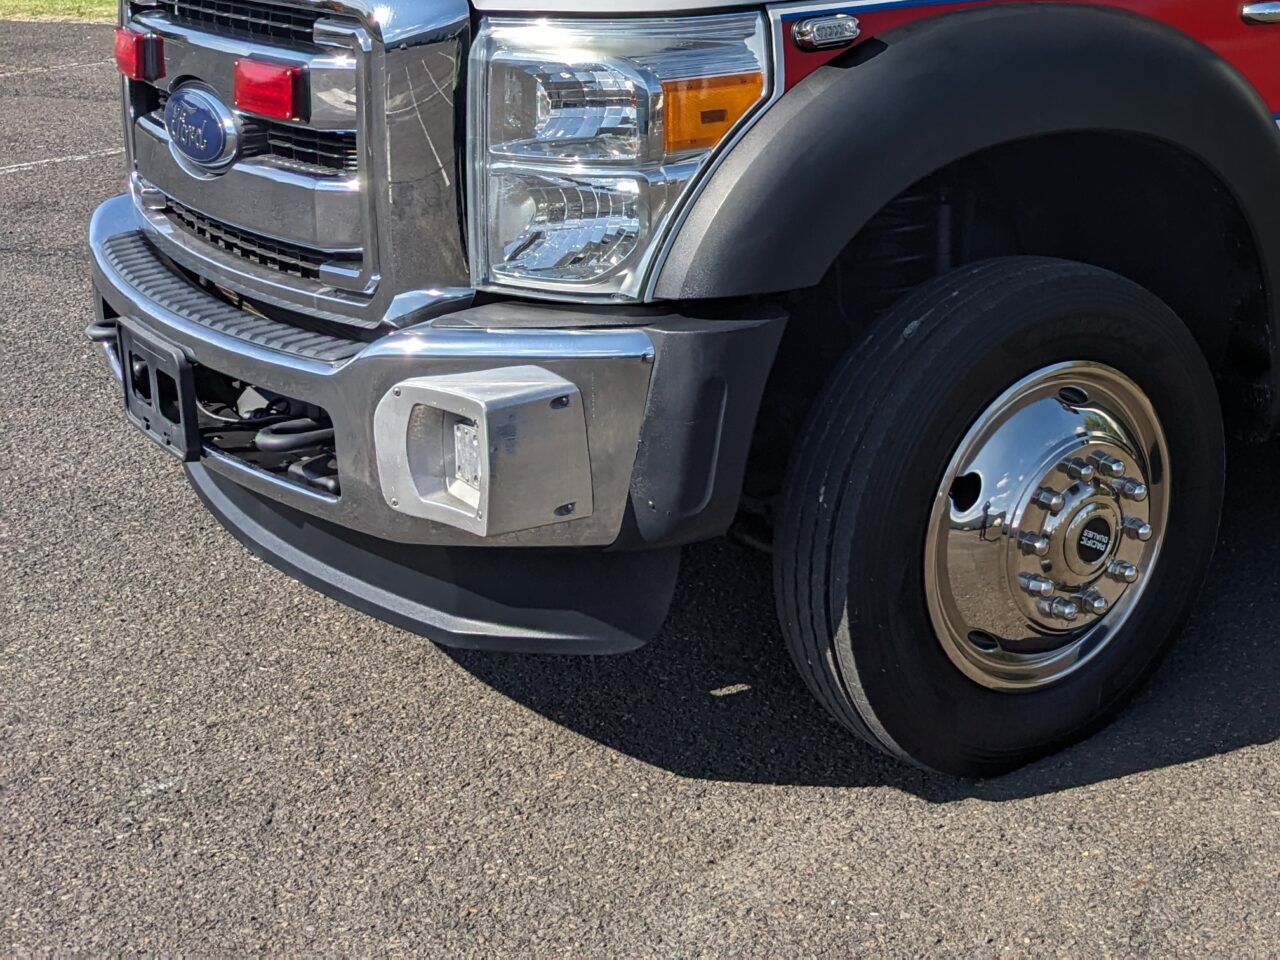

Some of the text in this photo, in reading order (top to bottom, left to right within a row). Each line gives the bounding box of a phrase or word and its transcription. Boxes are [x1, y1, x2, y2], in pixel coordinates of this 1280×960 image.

[171, 101, 209, 151] Ford
[1083, 529, 1109, 543] DUALIES
[1080, 537, 1106, 551] PACIFIC
